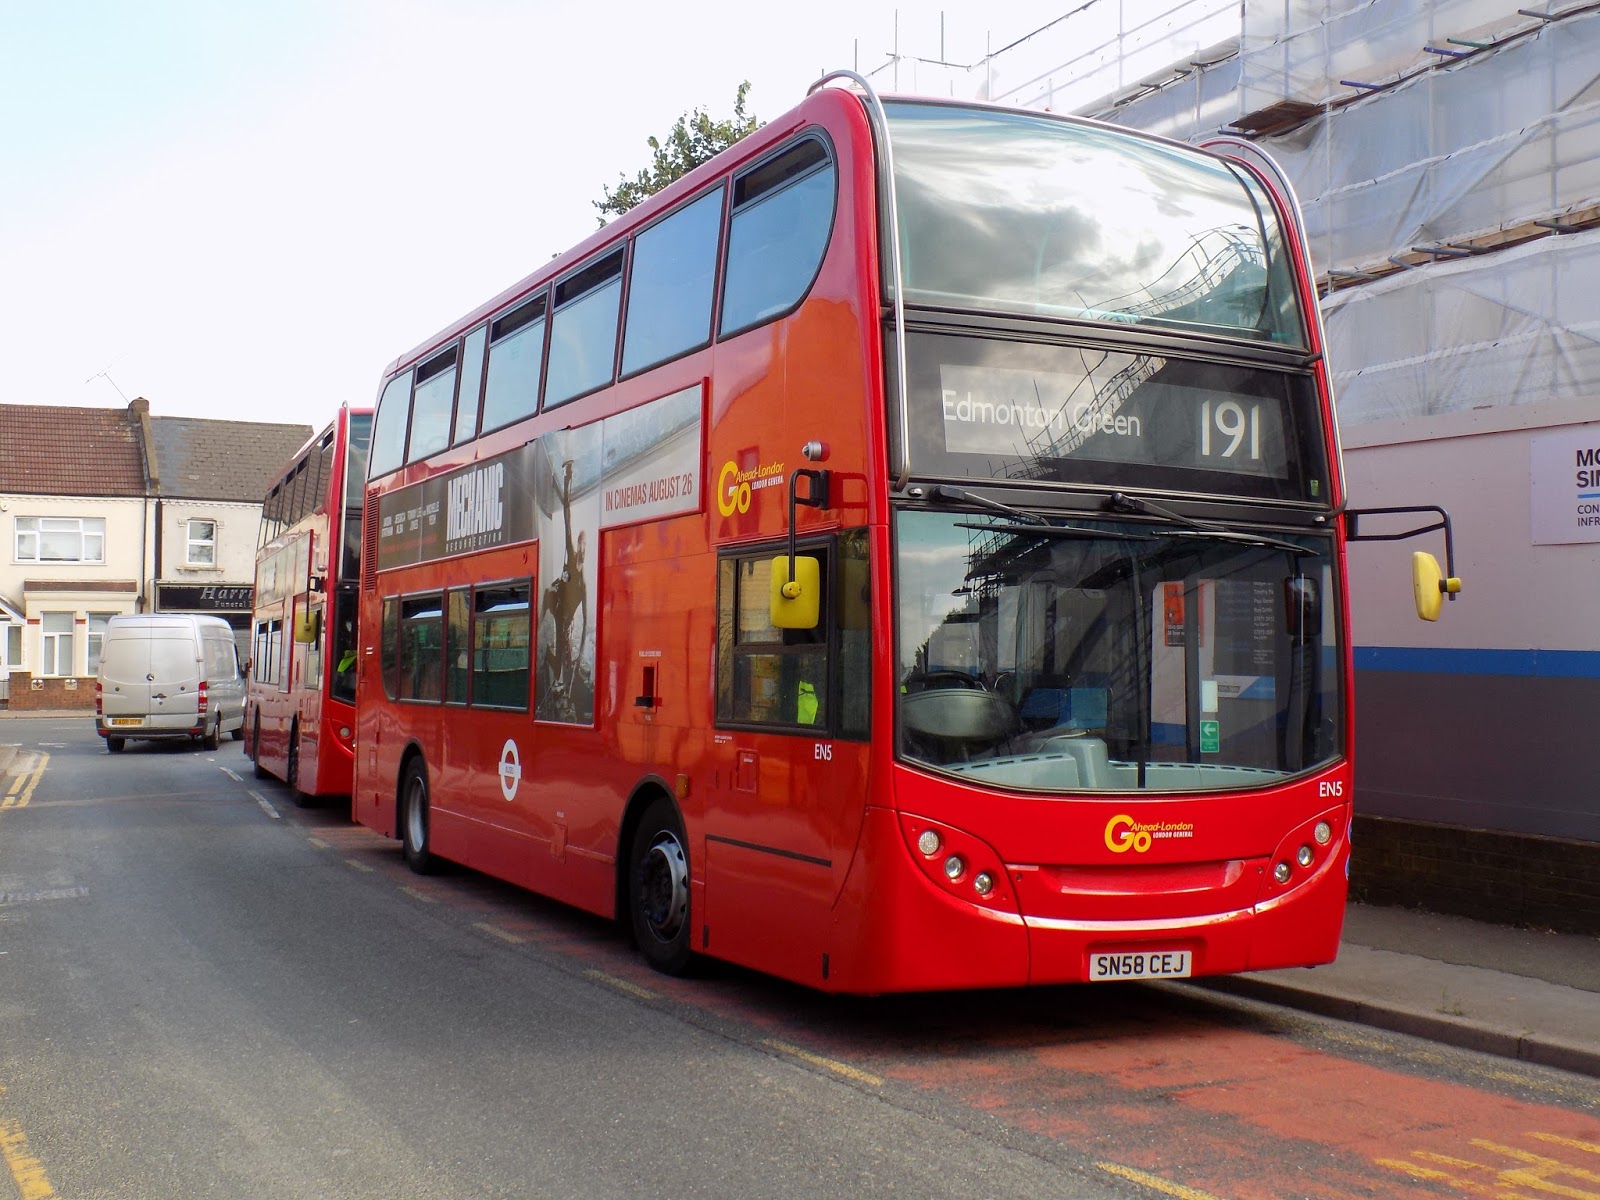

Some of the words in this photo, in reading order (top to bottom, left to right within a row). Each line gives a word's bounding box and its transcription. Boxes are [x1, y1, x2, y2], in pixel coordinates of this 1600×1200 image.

[942, 389, 1063, 430] Edmonton
[1072, 402, 1141, 437] Green
[1200, 398, 1260, 460] 191
[446, 461, 504, 542] MECHANIC
[605, 490, 613, 512] IN
[614, 482, 648, 510] CINEMAS
[648, 475, 681, 503] AUGUST
[681, 472, 693, 496] 26
[717, 460, 751, 518] Go
[735, 461, 785, 484] Ahead-London
[445, 530, 503, 554] RESURRECTION
[814, 743, 833, 761] EN5
[1318, 781, 1343, 798] EN5
[1104, 814, 1152, 854] Go
[1130, 821, 1194, 832] Ahead-London
[1152, 831, 1173, 839] LONDON
[1097, 955, 1145, 977] SN58
[1149, 953, 1184, 975] CEJ
